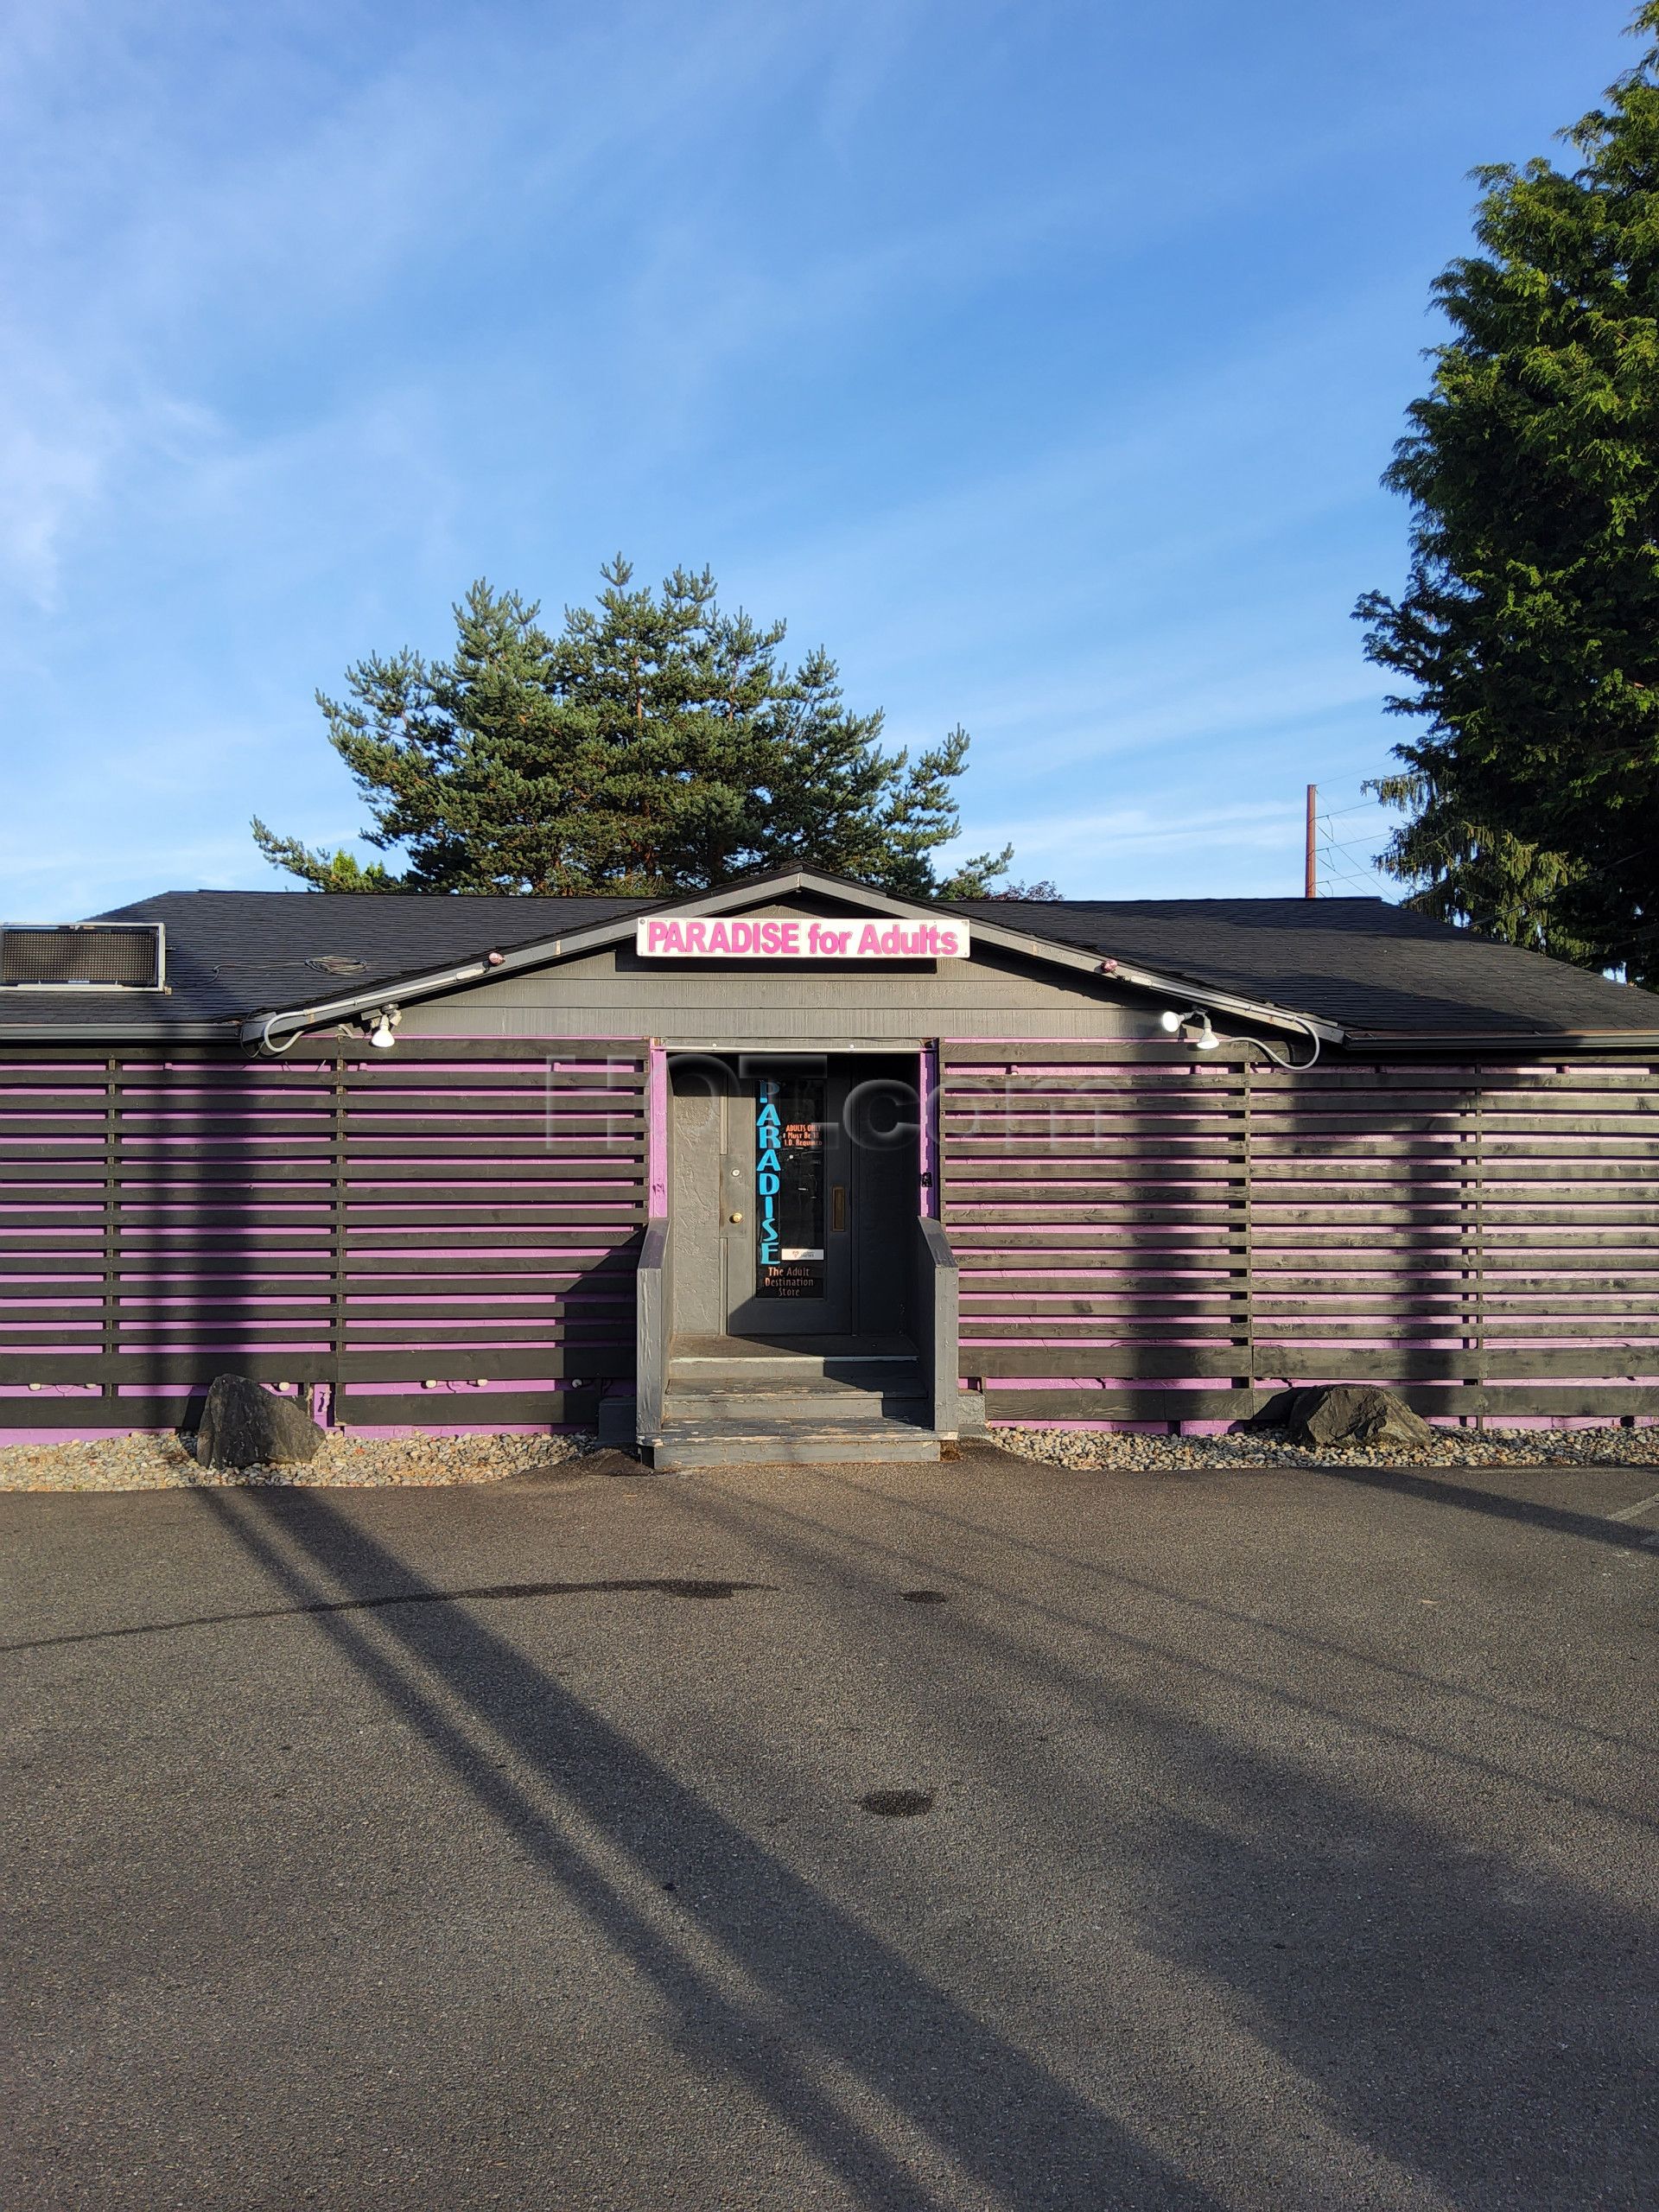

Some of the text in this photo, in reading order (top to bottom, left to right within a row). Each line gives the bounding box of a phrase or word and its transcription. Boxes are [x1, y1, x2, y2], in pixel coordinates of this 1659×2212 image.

[648, 922, 960, 955] PARADISE for Adults
[756, 1080, 781, 1265] PARADISE
[768, 1267, 810, 1276] The Adult
[765, 1278, 814, 1287] Destination
[779, 1287, 800, 1296] Store
